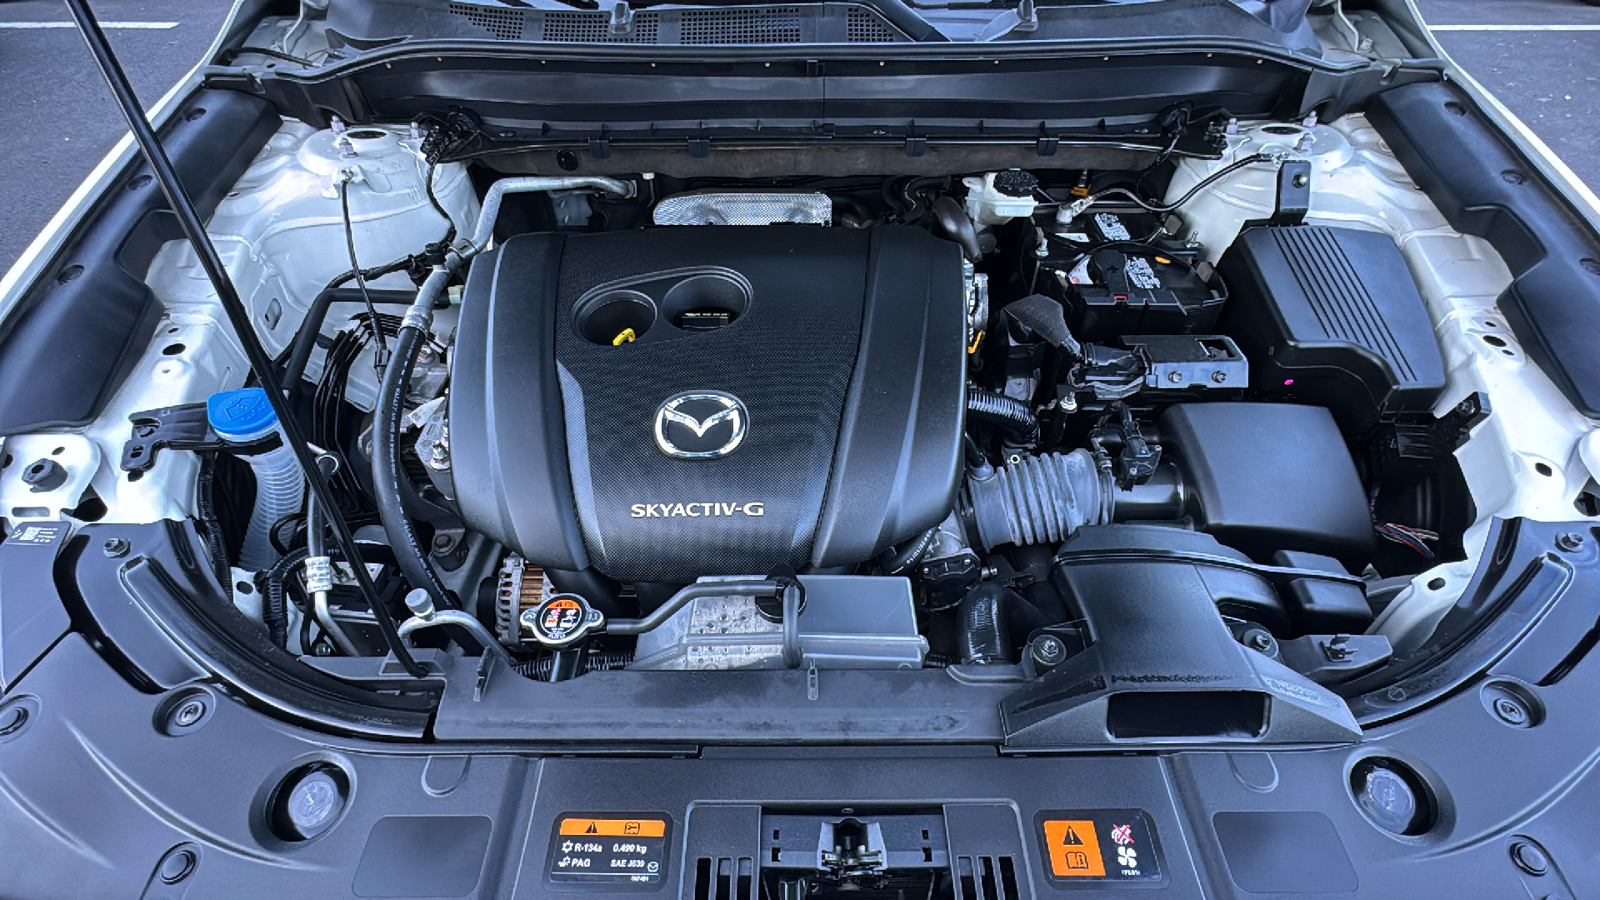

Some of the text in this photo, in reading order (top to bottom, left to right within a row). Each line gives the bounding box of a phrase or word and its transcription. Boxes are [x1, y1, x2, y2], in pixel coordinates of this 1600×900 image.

[630, 502, 764, 517] SKYACTIV-G
[574, 842, 647, 855] R-134a 0.490 kg
[571, 858, 645, 867] PAG SAE J639
